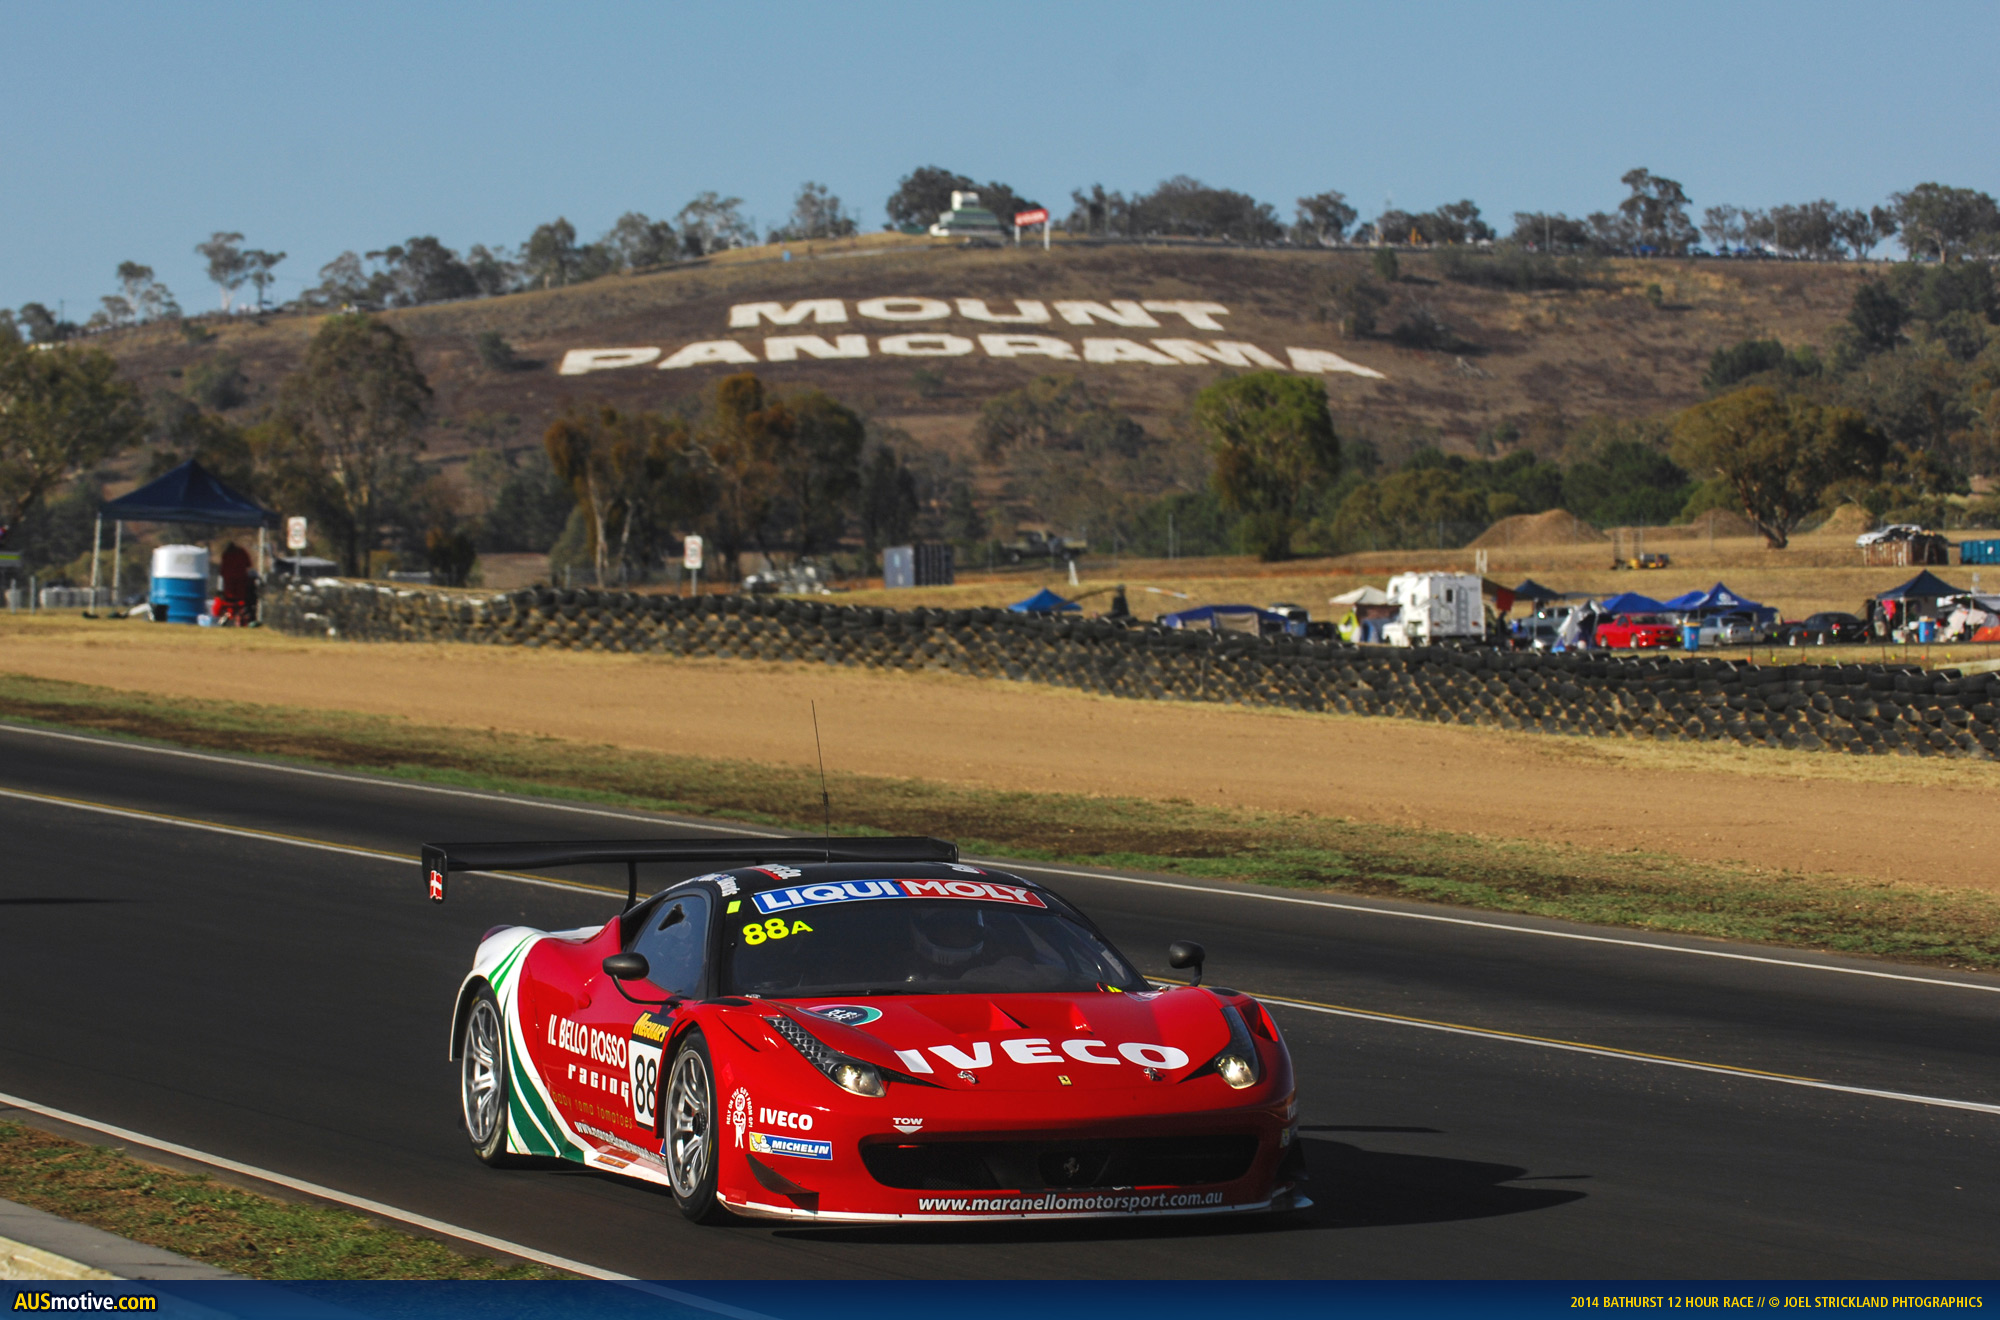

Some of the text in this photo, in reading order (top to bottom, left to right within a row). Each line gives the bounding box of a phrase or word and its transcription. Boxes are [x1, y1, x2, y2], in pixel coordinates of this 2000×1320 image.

[720, 297, 1230, 331] MOUNT
[558, 333, 1386, 379] PANORAMA
[761, 880, 900, 910] LIQUI
[901, 880, 1028, 903] MOLY
[742, 917, 814, 946] 88A
[547, 1013, 627, 1069] IL BELLO ROSSO
[893, 1038, 1190, 1075] IVECO
[567, 1063, 630, 1108] racing
[634, 1054, 657, 1119] 88
[728, 1099, 734, 1109] ON
[731, 1088, 739, 1099] THE
[759, 1107, 813, 1131] IVECO
[892, 1117, 923, 1126] TOW
[771, 1139, 830, 1155] MICHELIN
[917, 1191, 1223, 1212] www.maranellomotorsport.com.au
